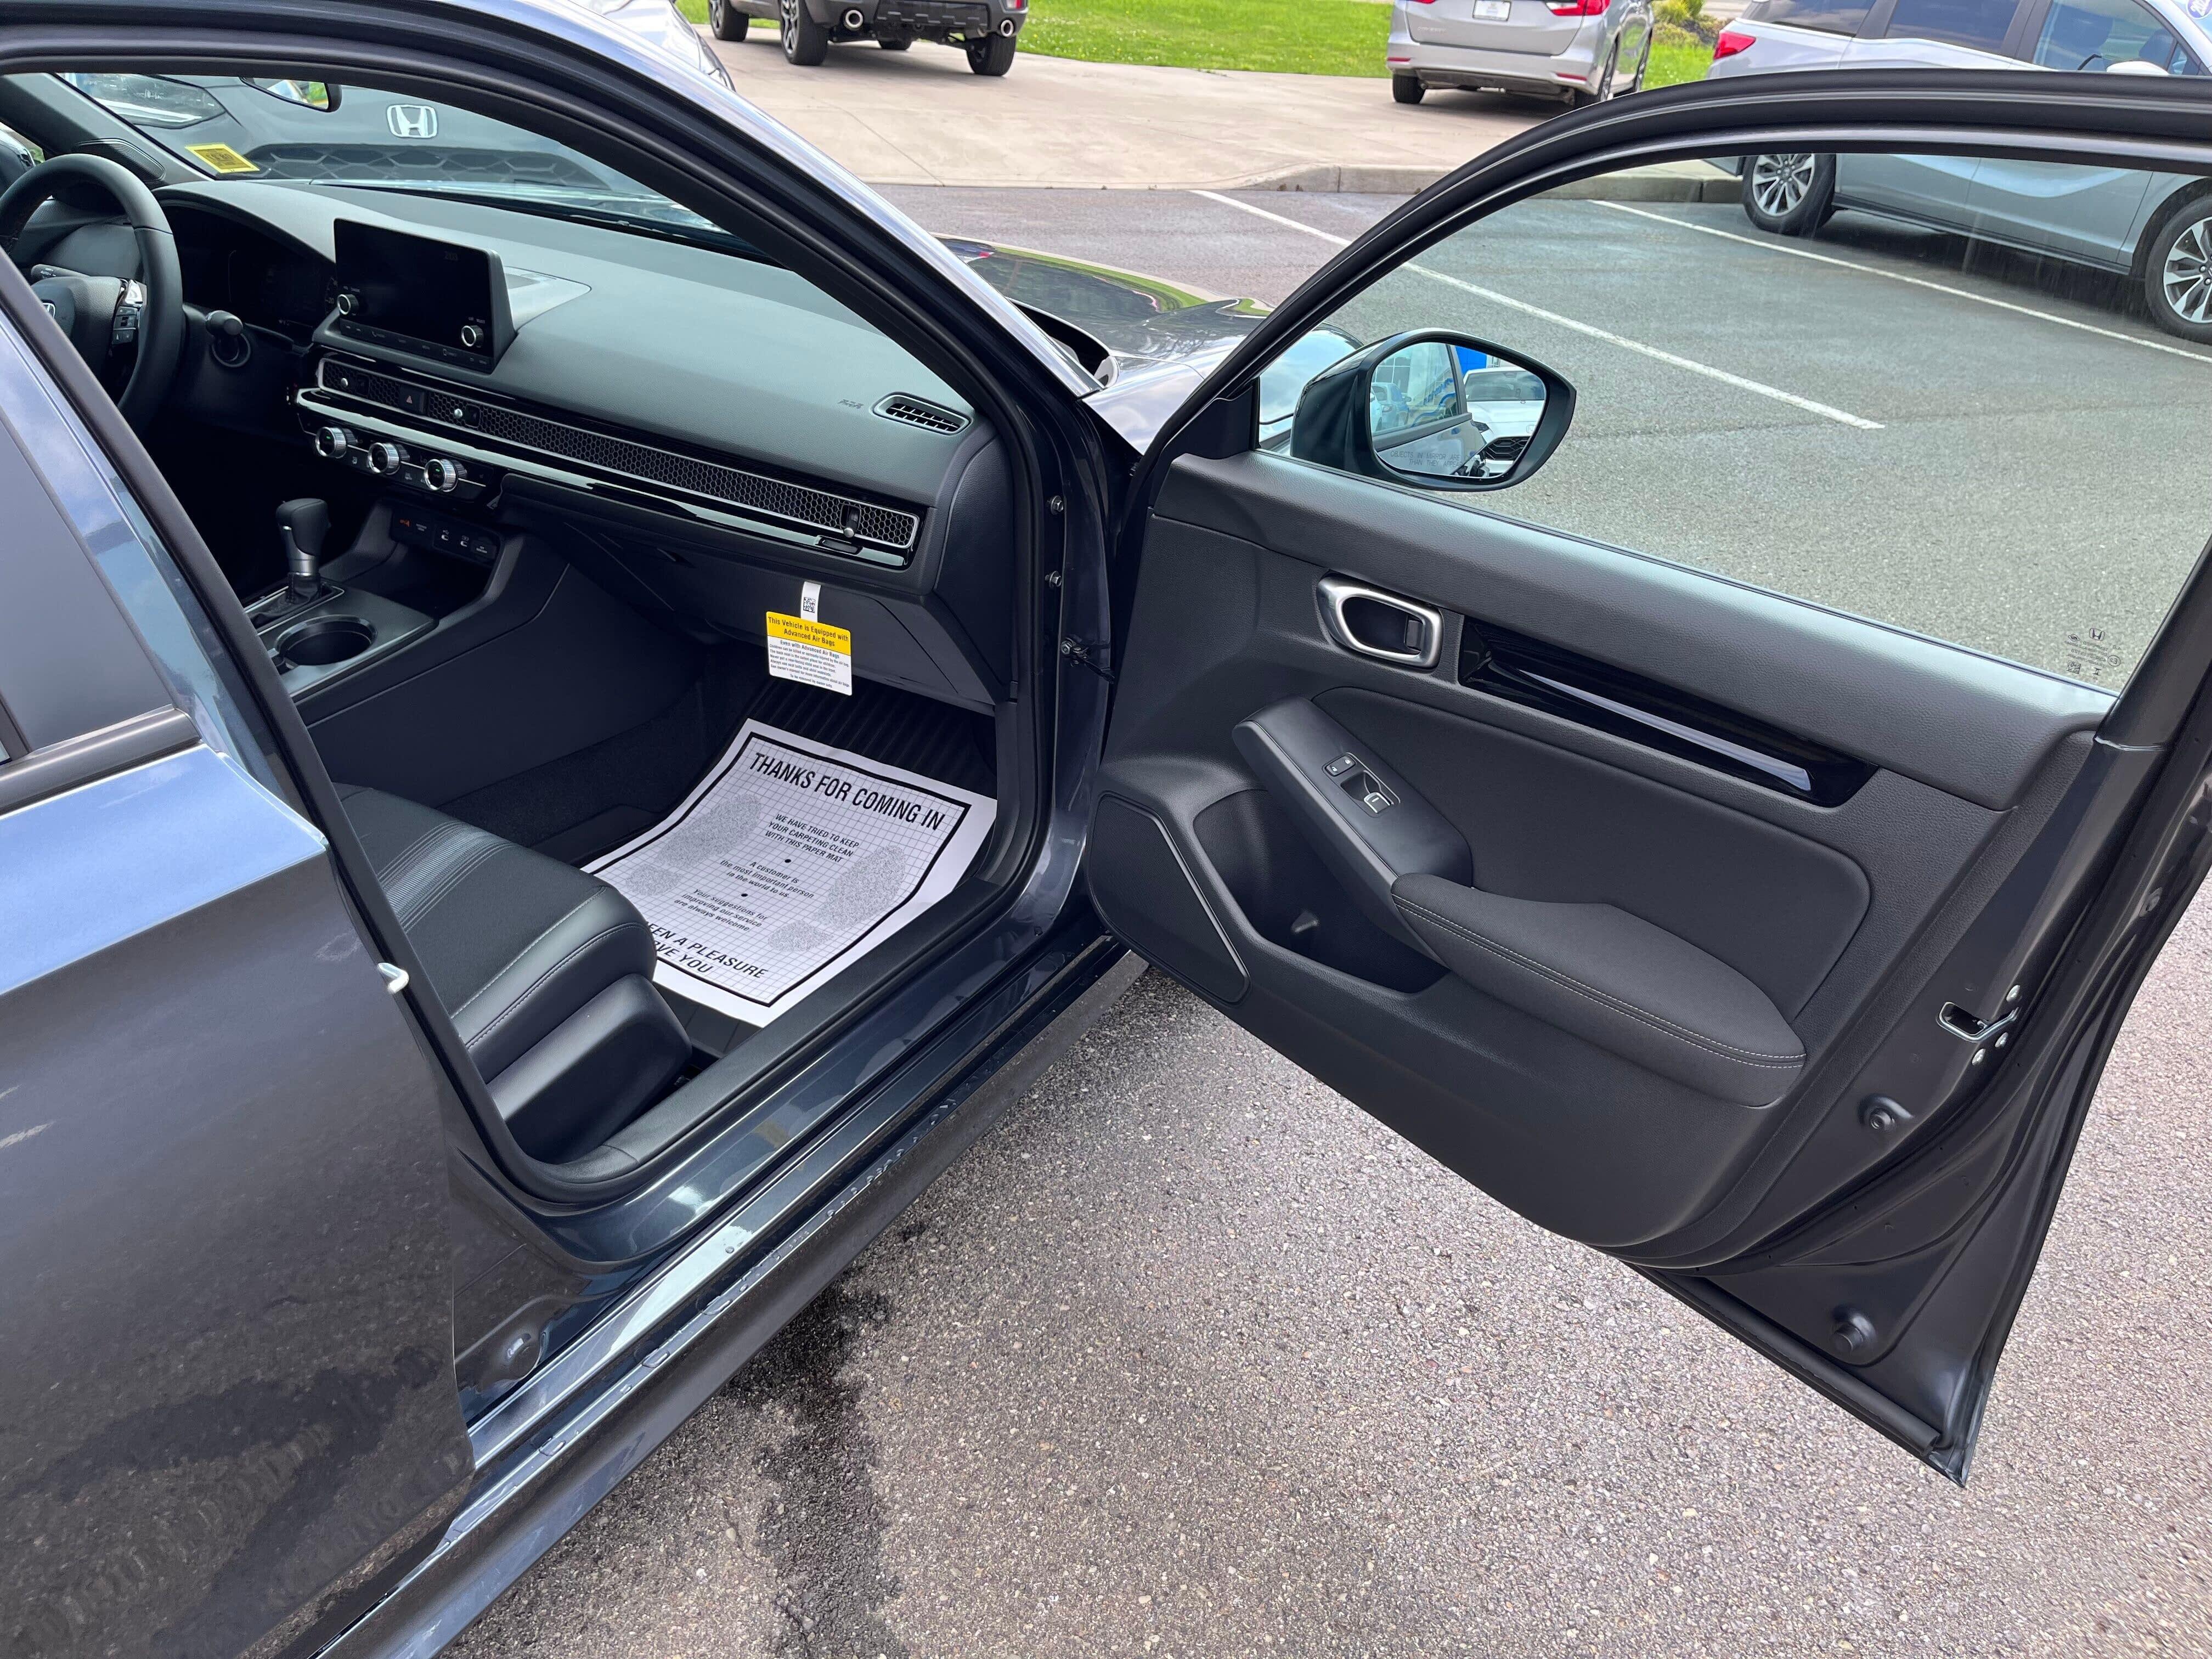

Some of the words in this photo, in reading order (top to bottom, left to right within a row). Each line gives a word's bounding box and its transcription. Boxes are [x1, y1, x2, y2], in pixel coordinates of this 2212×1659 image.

[1390, 450, 1414, 459] OBJECTS
[782, 619, 803, 629] Vehicle
[811, 627, 836, 638] Equipped
[785, 629, 810, 640] Advanced
[822, 637, 835, 646] Bags
[802, 645, 821, 653] Advanced
[749, 752, 816, 789] THANKS
[814, 775, 852, 802] FOR
[852, 788, 922, 823] COMING
[920, 809, 946, 831] IN
[768, 821, 789, 833] YOUR
[789, 829, 829, 848] CARPETING
[829, 844, 854, 857] CLEAN
[775, 814, 788, 823] WE
[787, 819, 808, 831] HAVE
[808, 826, 829, 838] TRIED
[829, 833, 840, 842] TO
[840, 838, 860, 848] KEEP
[765, 831, 785, 842] WITH
[785, 837, 802, 848] THIS
[803, 844, 826, 857] PAPER
[826, 854, 843, 863] MAT
[720, 860, 733, 868] the
[733, 865, 753, 875] most
[752, 872, 788, 889] important
[787, 886, 815, 899] person
[757, 864, 791, 881] customer
[749, 880, 770, 890] world
[681, 893, 719, 911] improving
[733, 913, 762, 927] service
[688, 904, 715, 918] always
[693, 889, 710, 898] Your
[711, 896, 755, 916] suggestions
[647, 922, 677, 939] EEN
[673, 937, 688, 946] A
[687, 942, 769, 978] PLEASURE
[679, 954, 714, 973] YOU
